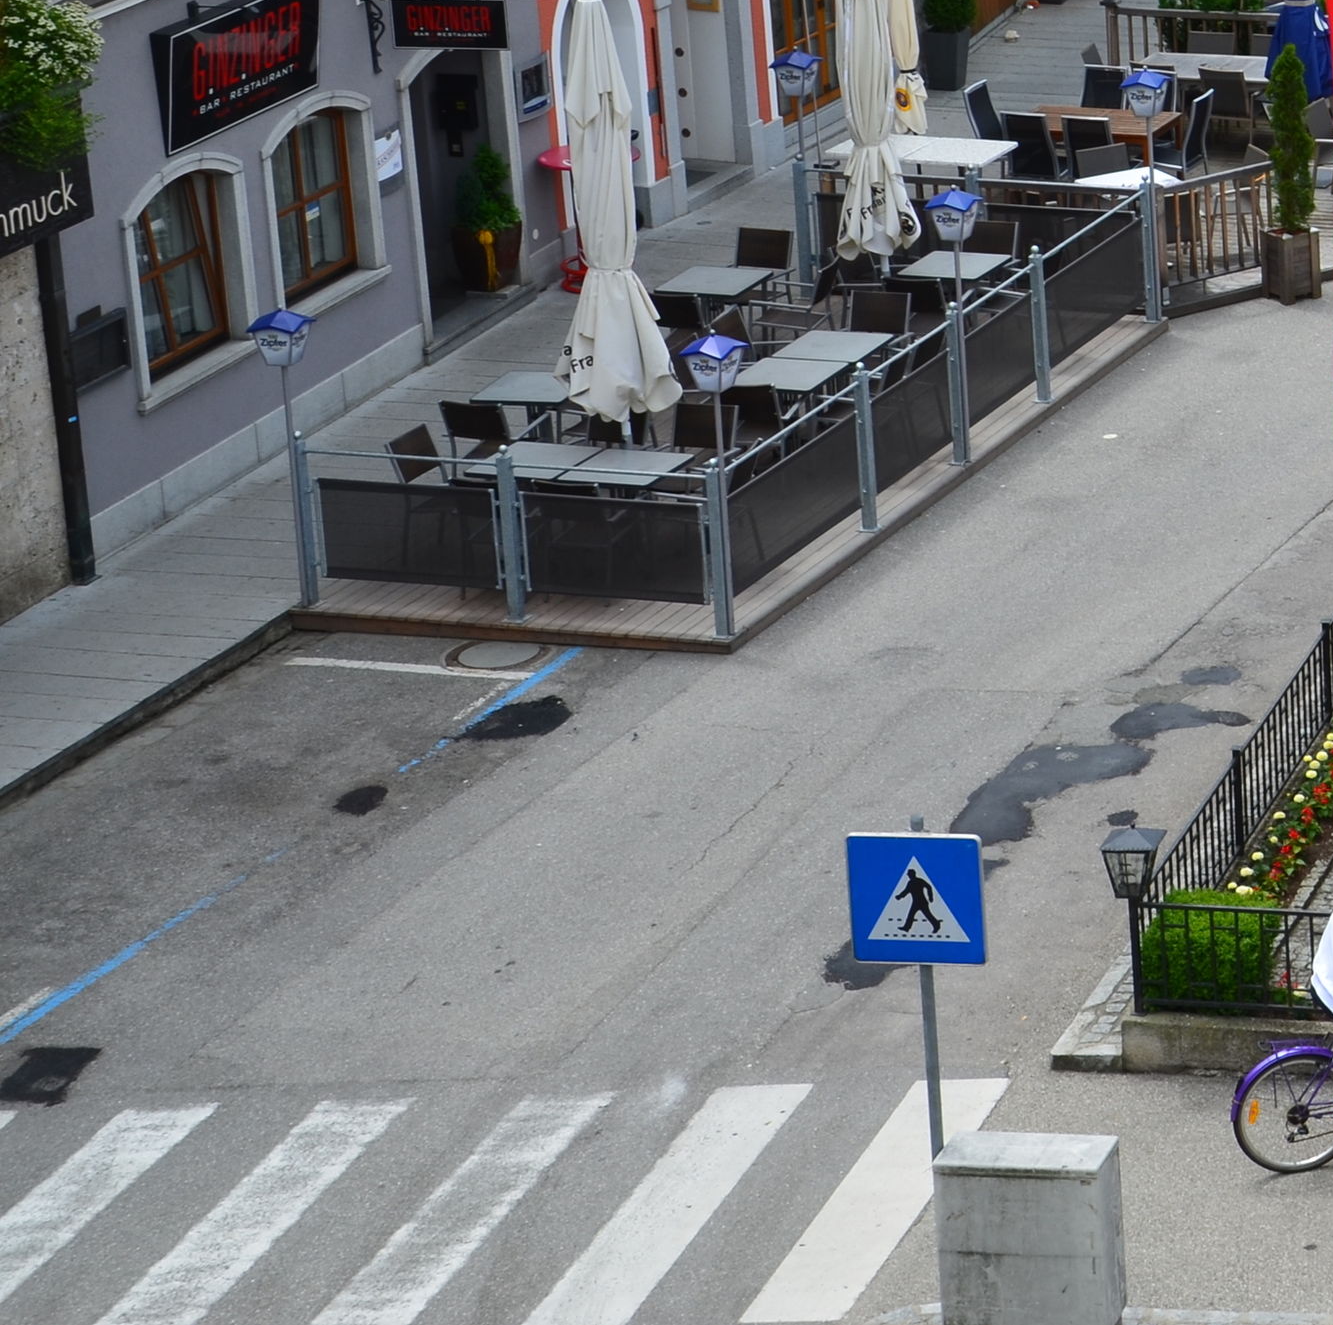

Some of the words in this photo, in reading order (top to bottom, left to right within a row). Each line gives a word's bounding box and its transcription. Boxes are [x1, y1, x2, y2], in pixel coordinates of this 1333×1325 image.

[200, 98, 220, 114] BAR
[230, 64, 295, 100] RESTAURANT
[936, 215, 960, 224] Zipfer
